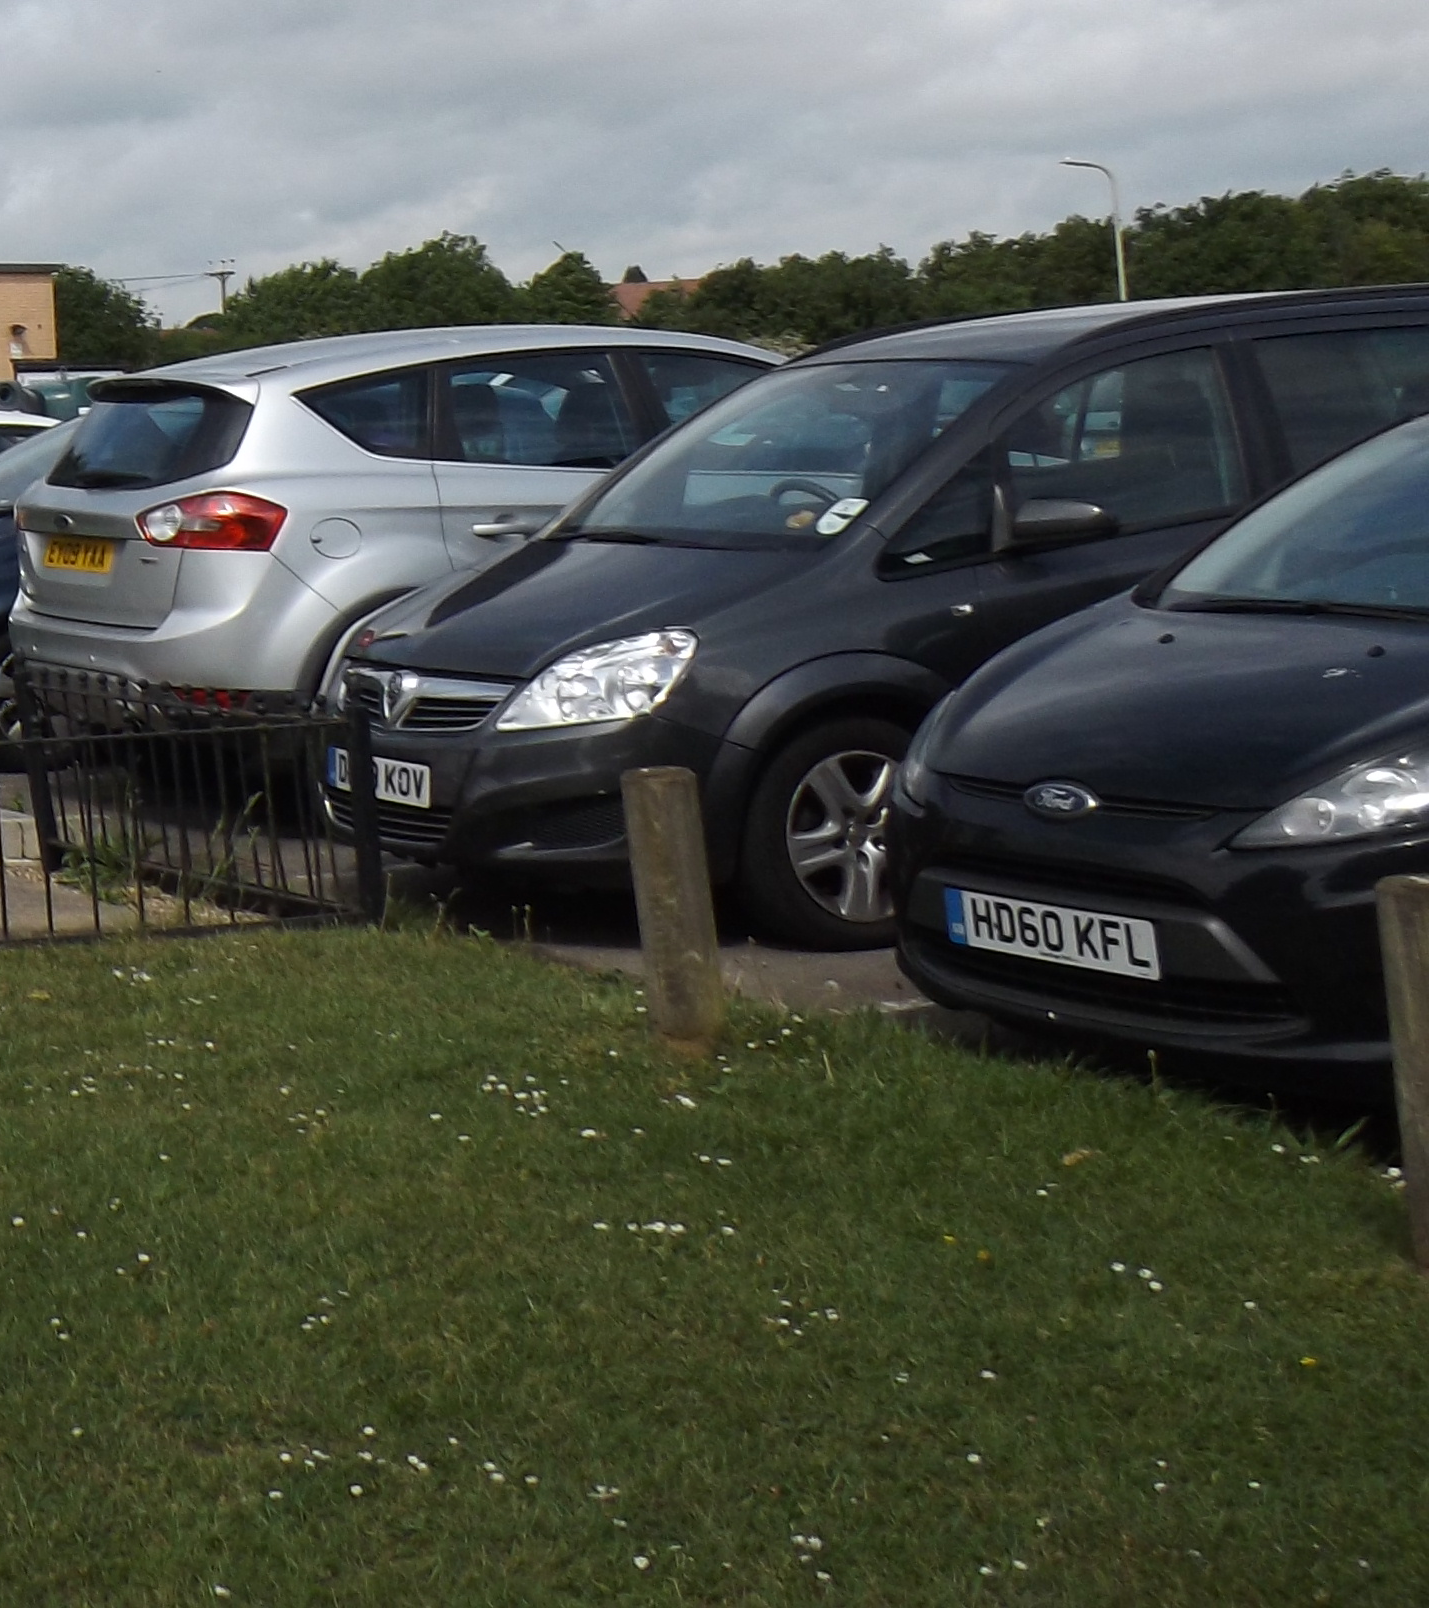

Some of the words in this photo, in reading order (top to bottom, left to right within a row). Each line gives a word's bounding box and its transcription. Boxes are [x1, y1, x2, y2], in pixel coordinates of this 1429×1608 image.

[384, 763, 424, 799] KOV
[970, 898, 1064, 952] HD60
[1073, 915, 1151, 969] KFL
